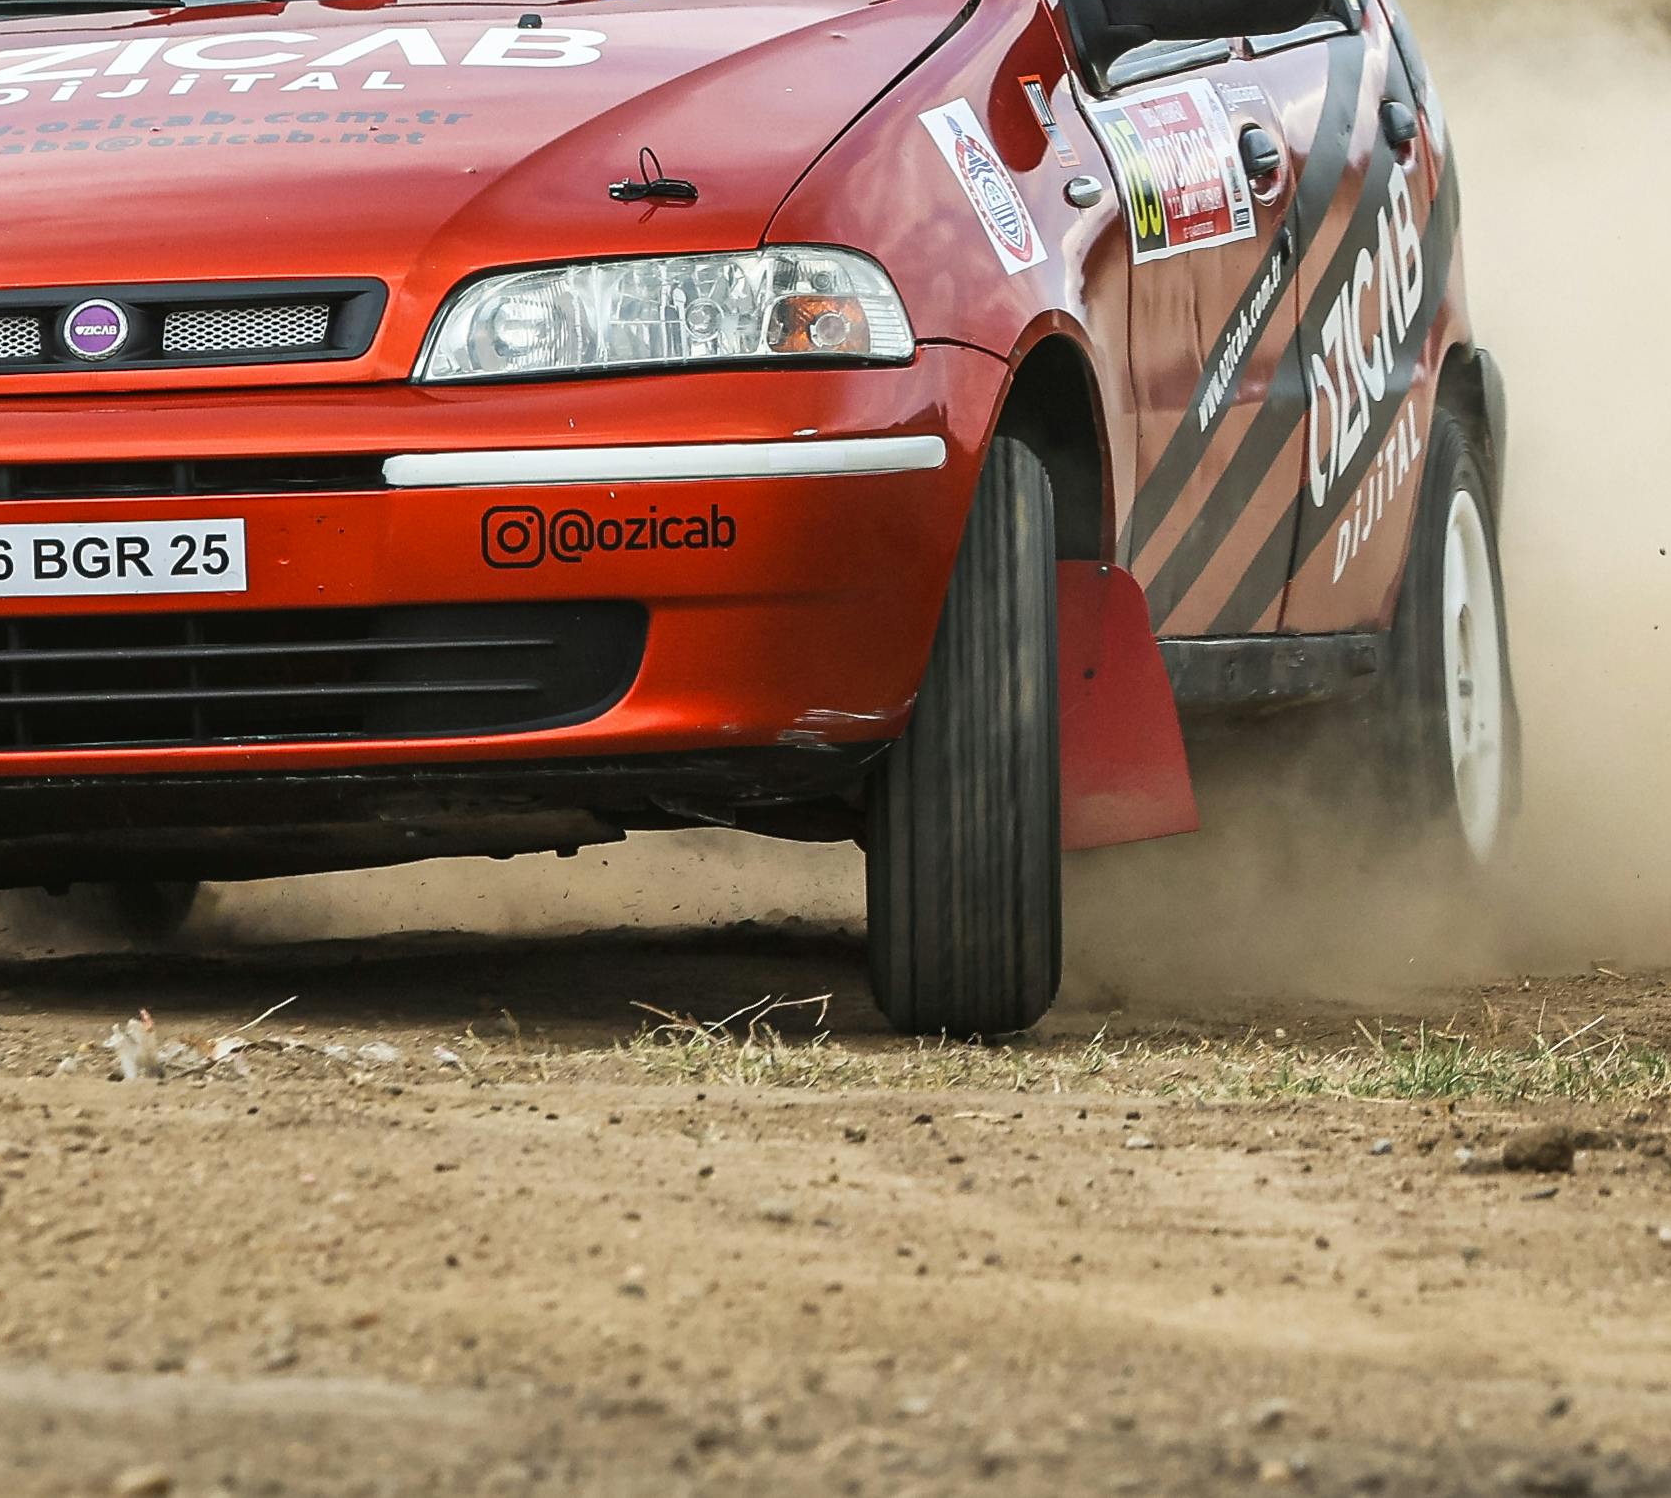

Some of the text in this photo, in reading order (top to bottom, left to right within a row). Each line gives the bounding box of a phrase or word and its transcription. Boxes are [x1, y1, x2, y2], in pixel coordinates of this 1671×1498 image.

[1103, 120, 1162, 239] 05
[1146, 127, 1220, 192] OTOKROS
[1198, 251, 1282, 433] www.ozicab.com.tr
[1308, 163, 1424, 508] OZICAB
[32, 535, 154, 580] BGR
[169, 533, 231, 576] 25
[549, 504, 738, 563] @ozicab
